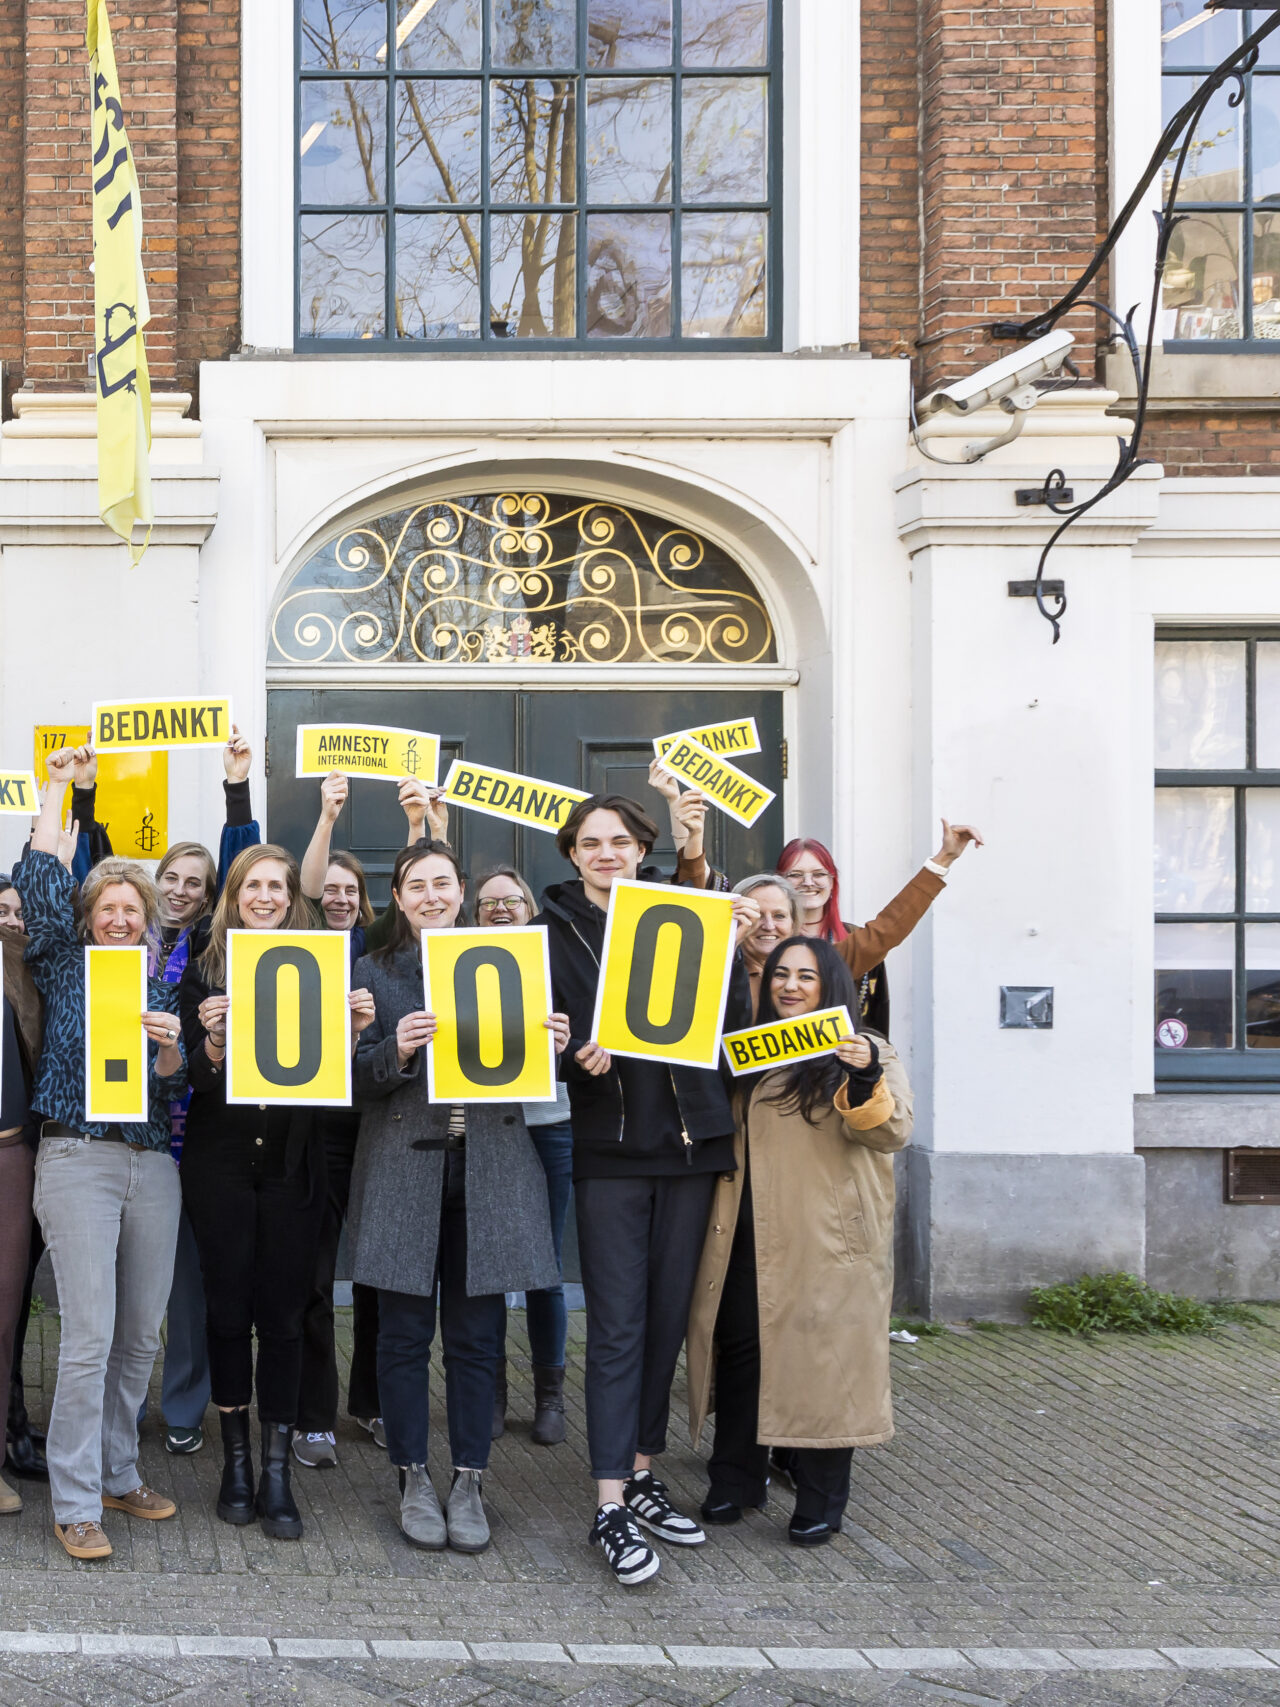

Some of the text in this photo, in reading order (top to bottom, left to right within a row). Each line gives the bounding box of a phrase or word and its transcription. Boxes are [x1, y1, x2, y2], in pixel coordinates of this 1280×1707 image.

[42, 733, 67, 749] 177
[99, 706, 223, 742] BEDANKT
[318, 735, 390, 754] AMNESTY
[318, 754, 388, 768] INTERNATIONAL
[670, 744, 763, 813] BEDANKT
[254, 945, 321, 1087] 0
[454, 945, 526, 1086] 0
[625, 903, 705, 1046] 0
[730, 1016, 841, 1066] BEDANKT
